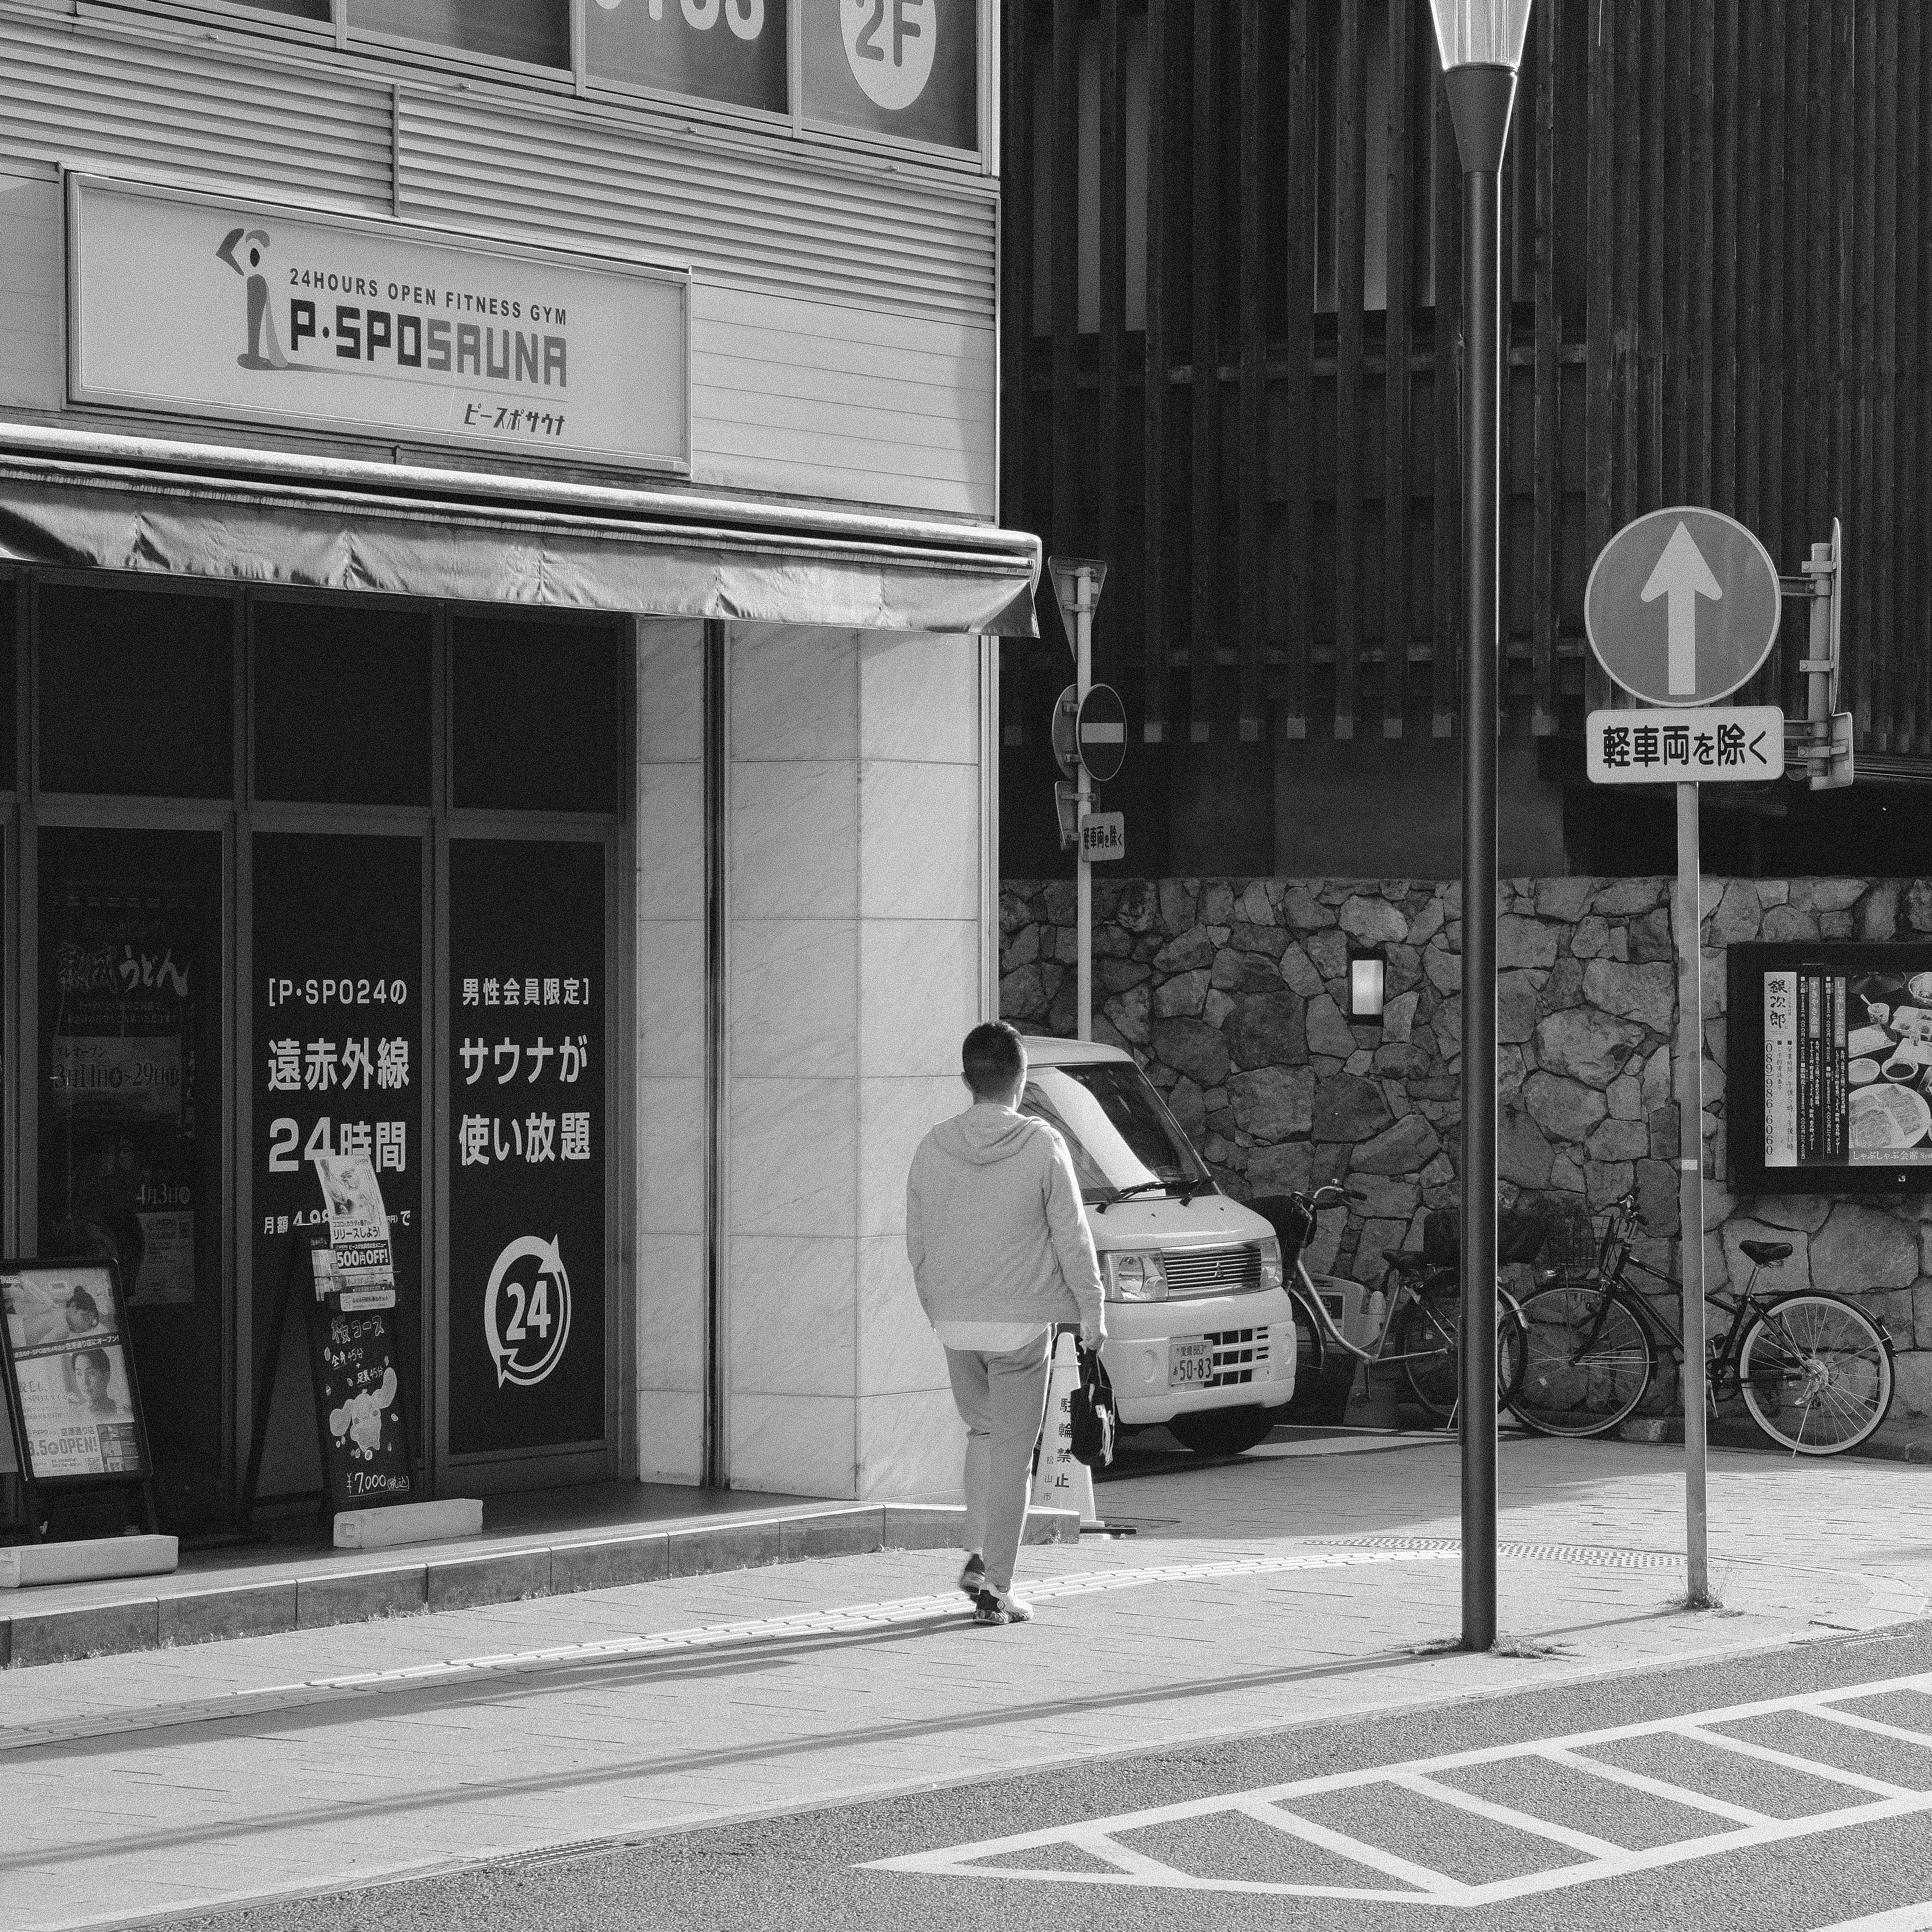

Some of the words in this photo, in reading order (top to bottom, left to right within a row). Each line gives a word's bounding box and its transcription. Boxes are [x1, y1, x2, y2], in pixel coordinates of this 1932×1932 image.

[289, 268, 378, 297] 24HOURS
[388, 283, 436, 306] OPEN
[446, 291, 521, 319] FITNESS
[530, 304, 567, 325] GYM
[464, 403, 566, 436] ピースポサウナ
[1603, 723, 1767, 768] 軽車両を除く
[1083, 825, 1122, 850] 軽車両を除く
[268, 1037, 410, 1092] 遠赤外線
[459, 1034, 588, 1085] サウナが
[269, 1116, 406, 1173] 24時間
[458, 1112, 591, 1166] 使い放題
[1853, 1151, 1918, 1160] しゃぶしゃぶ会席
[506, 1280, 551, 1341] 24
[1180, 1358, 1211, 1381] 50-83
[1054, 1398, 1073, 1488] 駐輪禁止
[1043, 1455, 1054, 1501] 松山市
